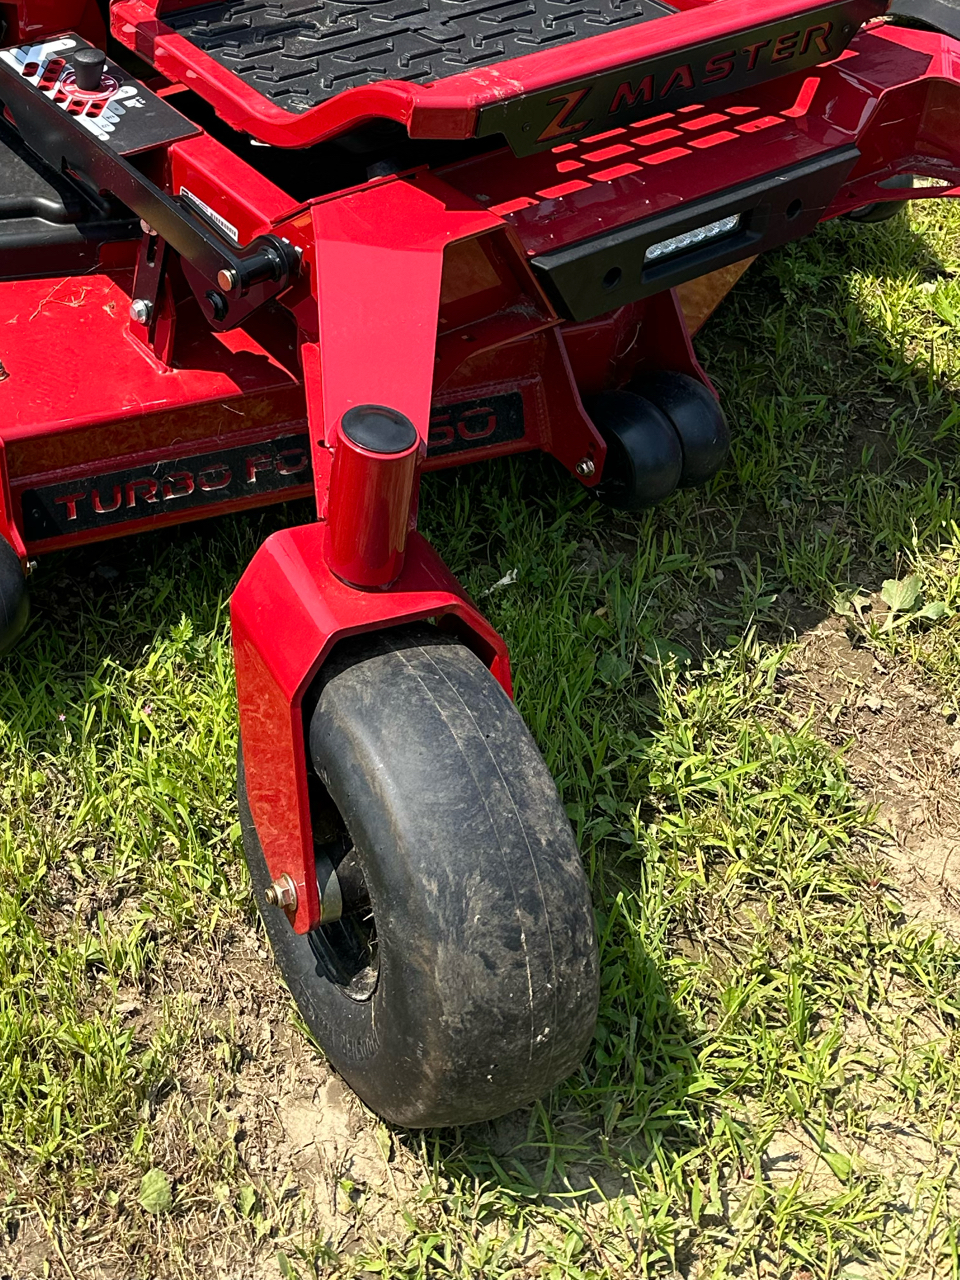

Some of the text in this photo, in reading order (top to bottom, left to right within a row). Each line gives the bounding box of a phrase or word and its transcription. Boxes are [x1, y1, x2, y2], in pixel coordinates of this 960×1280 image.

[537, 21, 834, 143] Z MASTER
[54, 463, 233, 521] TURBO
